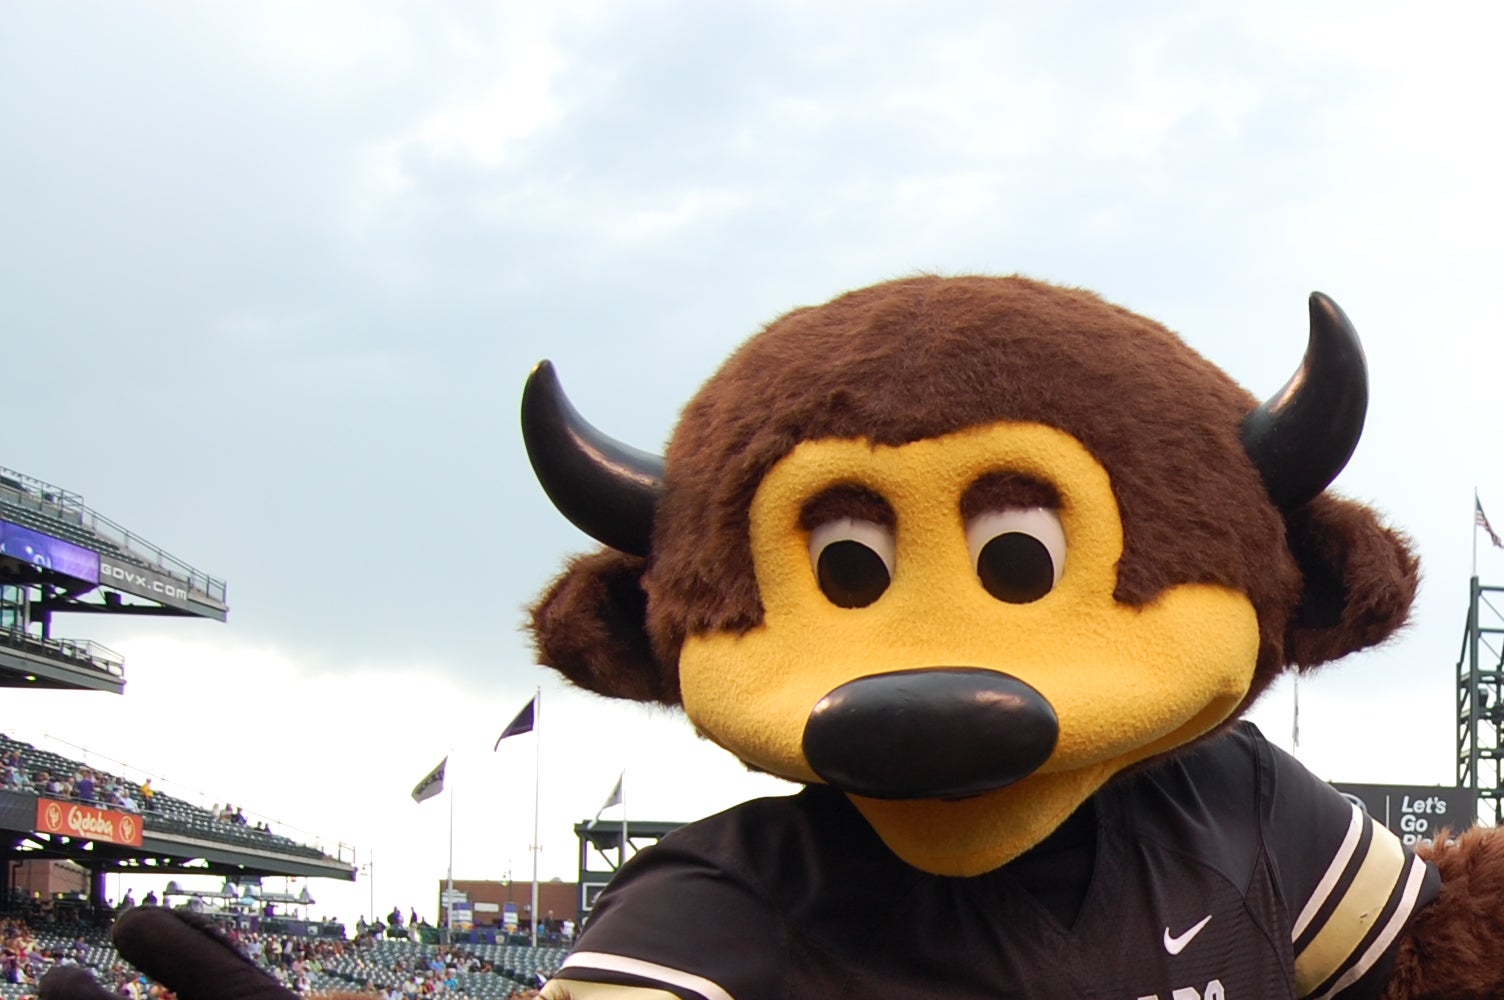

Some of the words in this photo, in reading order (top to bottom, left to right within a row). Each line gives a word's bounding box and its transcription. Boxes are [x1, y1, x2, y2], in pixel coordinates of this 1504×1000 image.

[1401, 795, 1447, 814] Let's
[68, 805, 113, 836] Qdoba
[1400, 814, 1428, 832] Go
